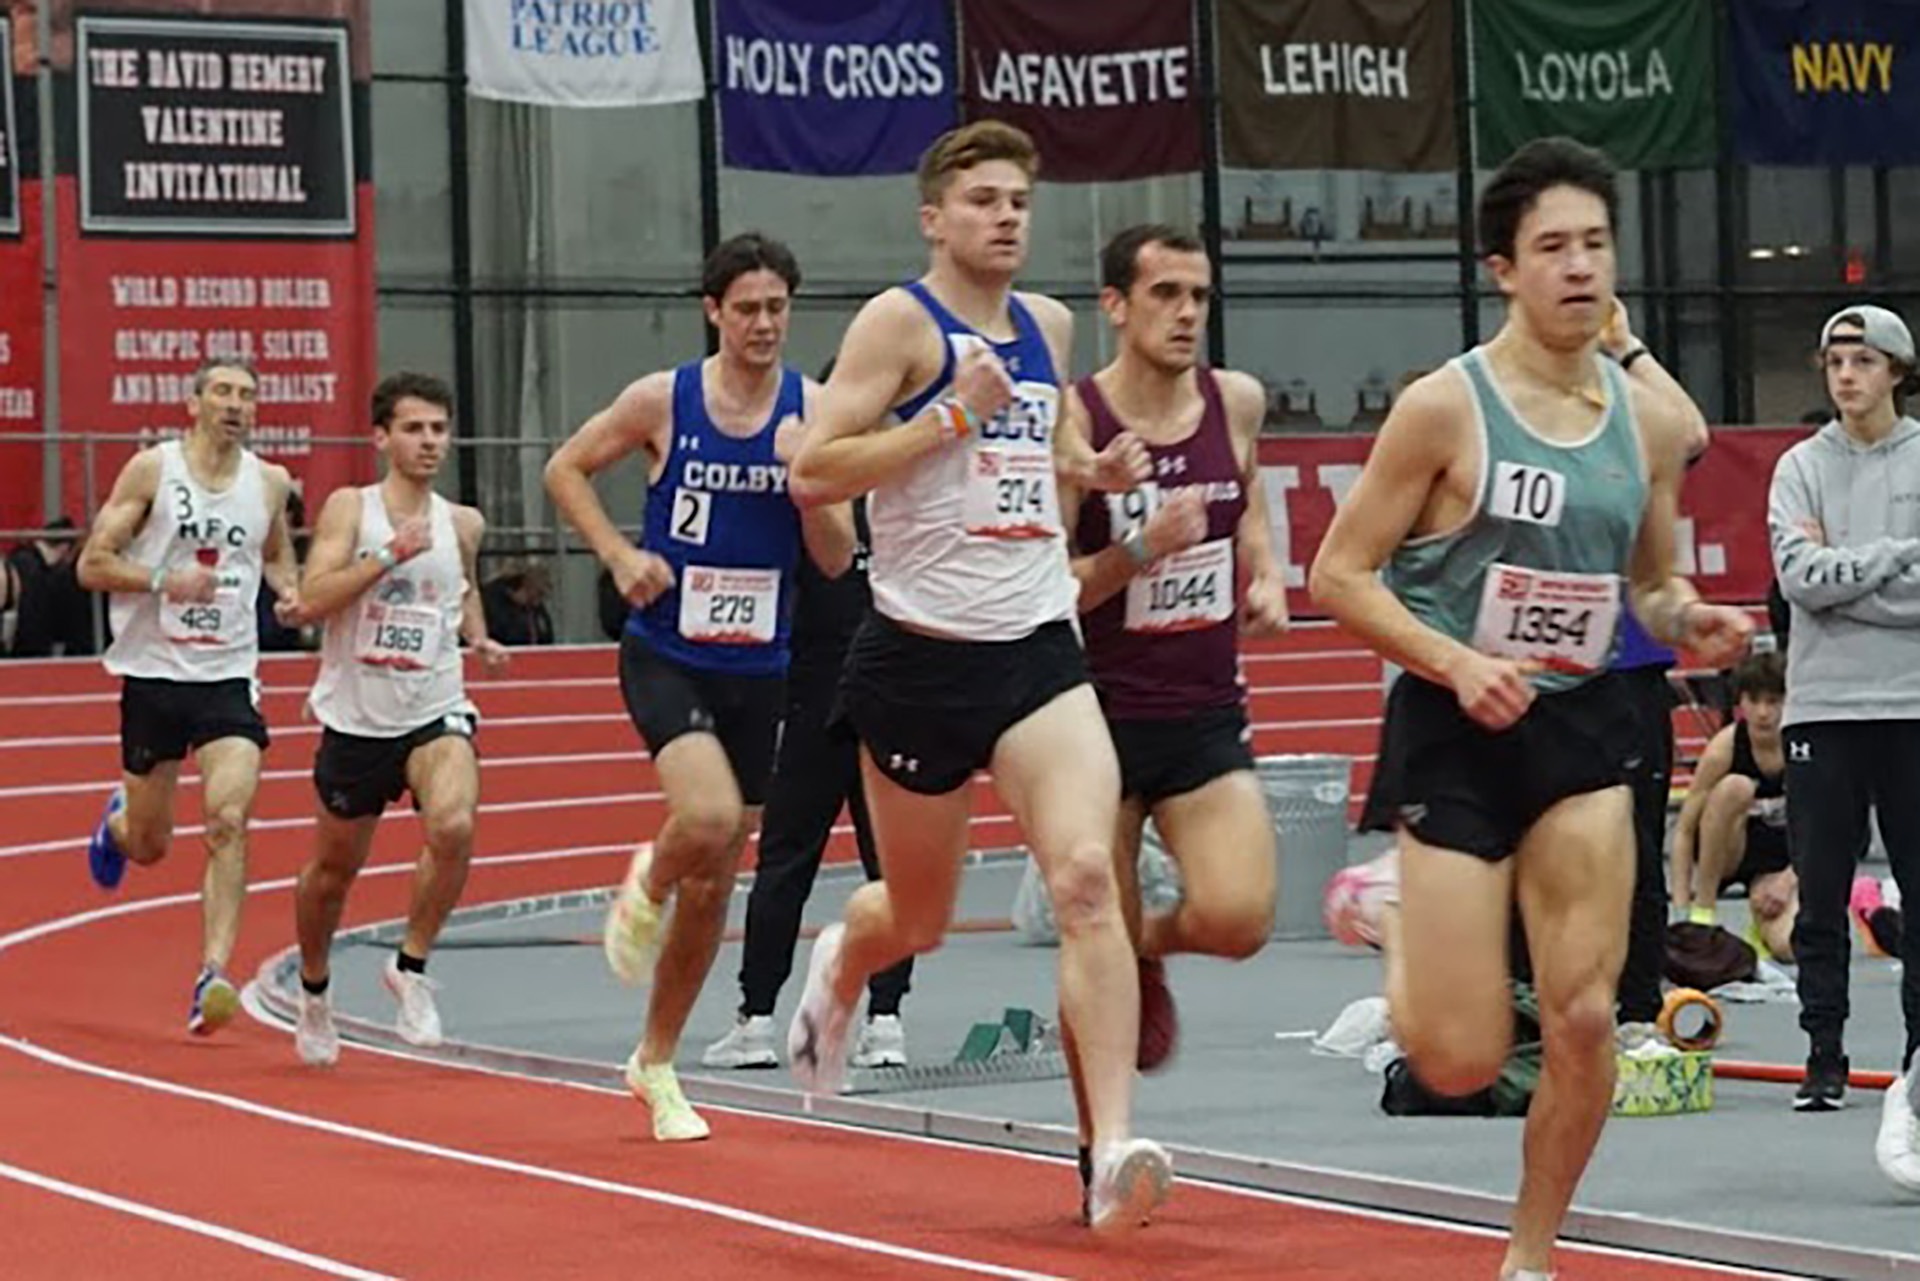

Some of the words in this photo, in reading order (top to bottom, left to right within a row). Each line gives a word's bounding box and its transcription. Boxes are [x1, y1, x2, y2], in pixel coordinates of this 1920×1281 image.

[511, 0, 650, 27] PATRIOT
[513, 23, 661, 58] LEAGUE
[89, 49, 139, 87] THE
[148, 50, 222, 89] DAVID
[229, 53, 325, 94] HEMERY
[726, 35, 812, 96] HOLY
[824, 42, 944, 99] CROSS
[972, 46, 1188, 107] LAFAYETTE
[1261, 44, 1409, 98] LEHIGH
[1516, 48, 1672, 101] LOYOLA
[1792, 43, 1893, 93] NAVY
[141, 106, 284, 147] VALENTINE
[124, 162, 307, 203] INVITATIONAL
[111, 276, 177, 307] WORLD
[184, 277, 256, 308] RECORD
[262, 277, 331, 308] HOLDER
[114, 329, 200, 360] OLYMPIC
[263, 330, 329, 360] SILVER
[112, 373, 152, 404] AND
[683, 460, 788, 493] COLBY
[997, 478, 1044, 514] 374
[1509, 467, 1554, 520] 10
[175, 485, 194, 521] 3
[677, 493, 701, 539] 2
[1123, 487, 1147, 527] 9
[709, 593, 756, 624] 279
[1149, 572, 1217, 613] 1044
[180, 607, 222, 631] 429
[374, 624, 425, 652] 1369
[1505, 604, 1593, 647] 1354
